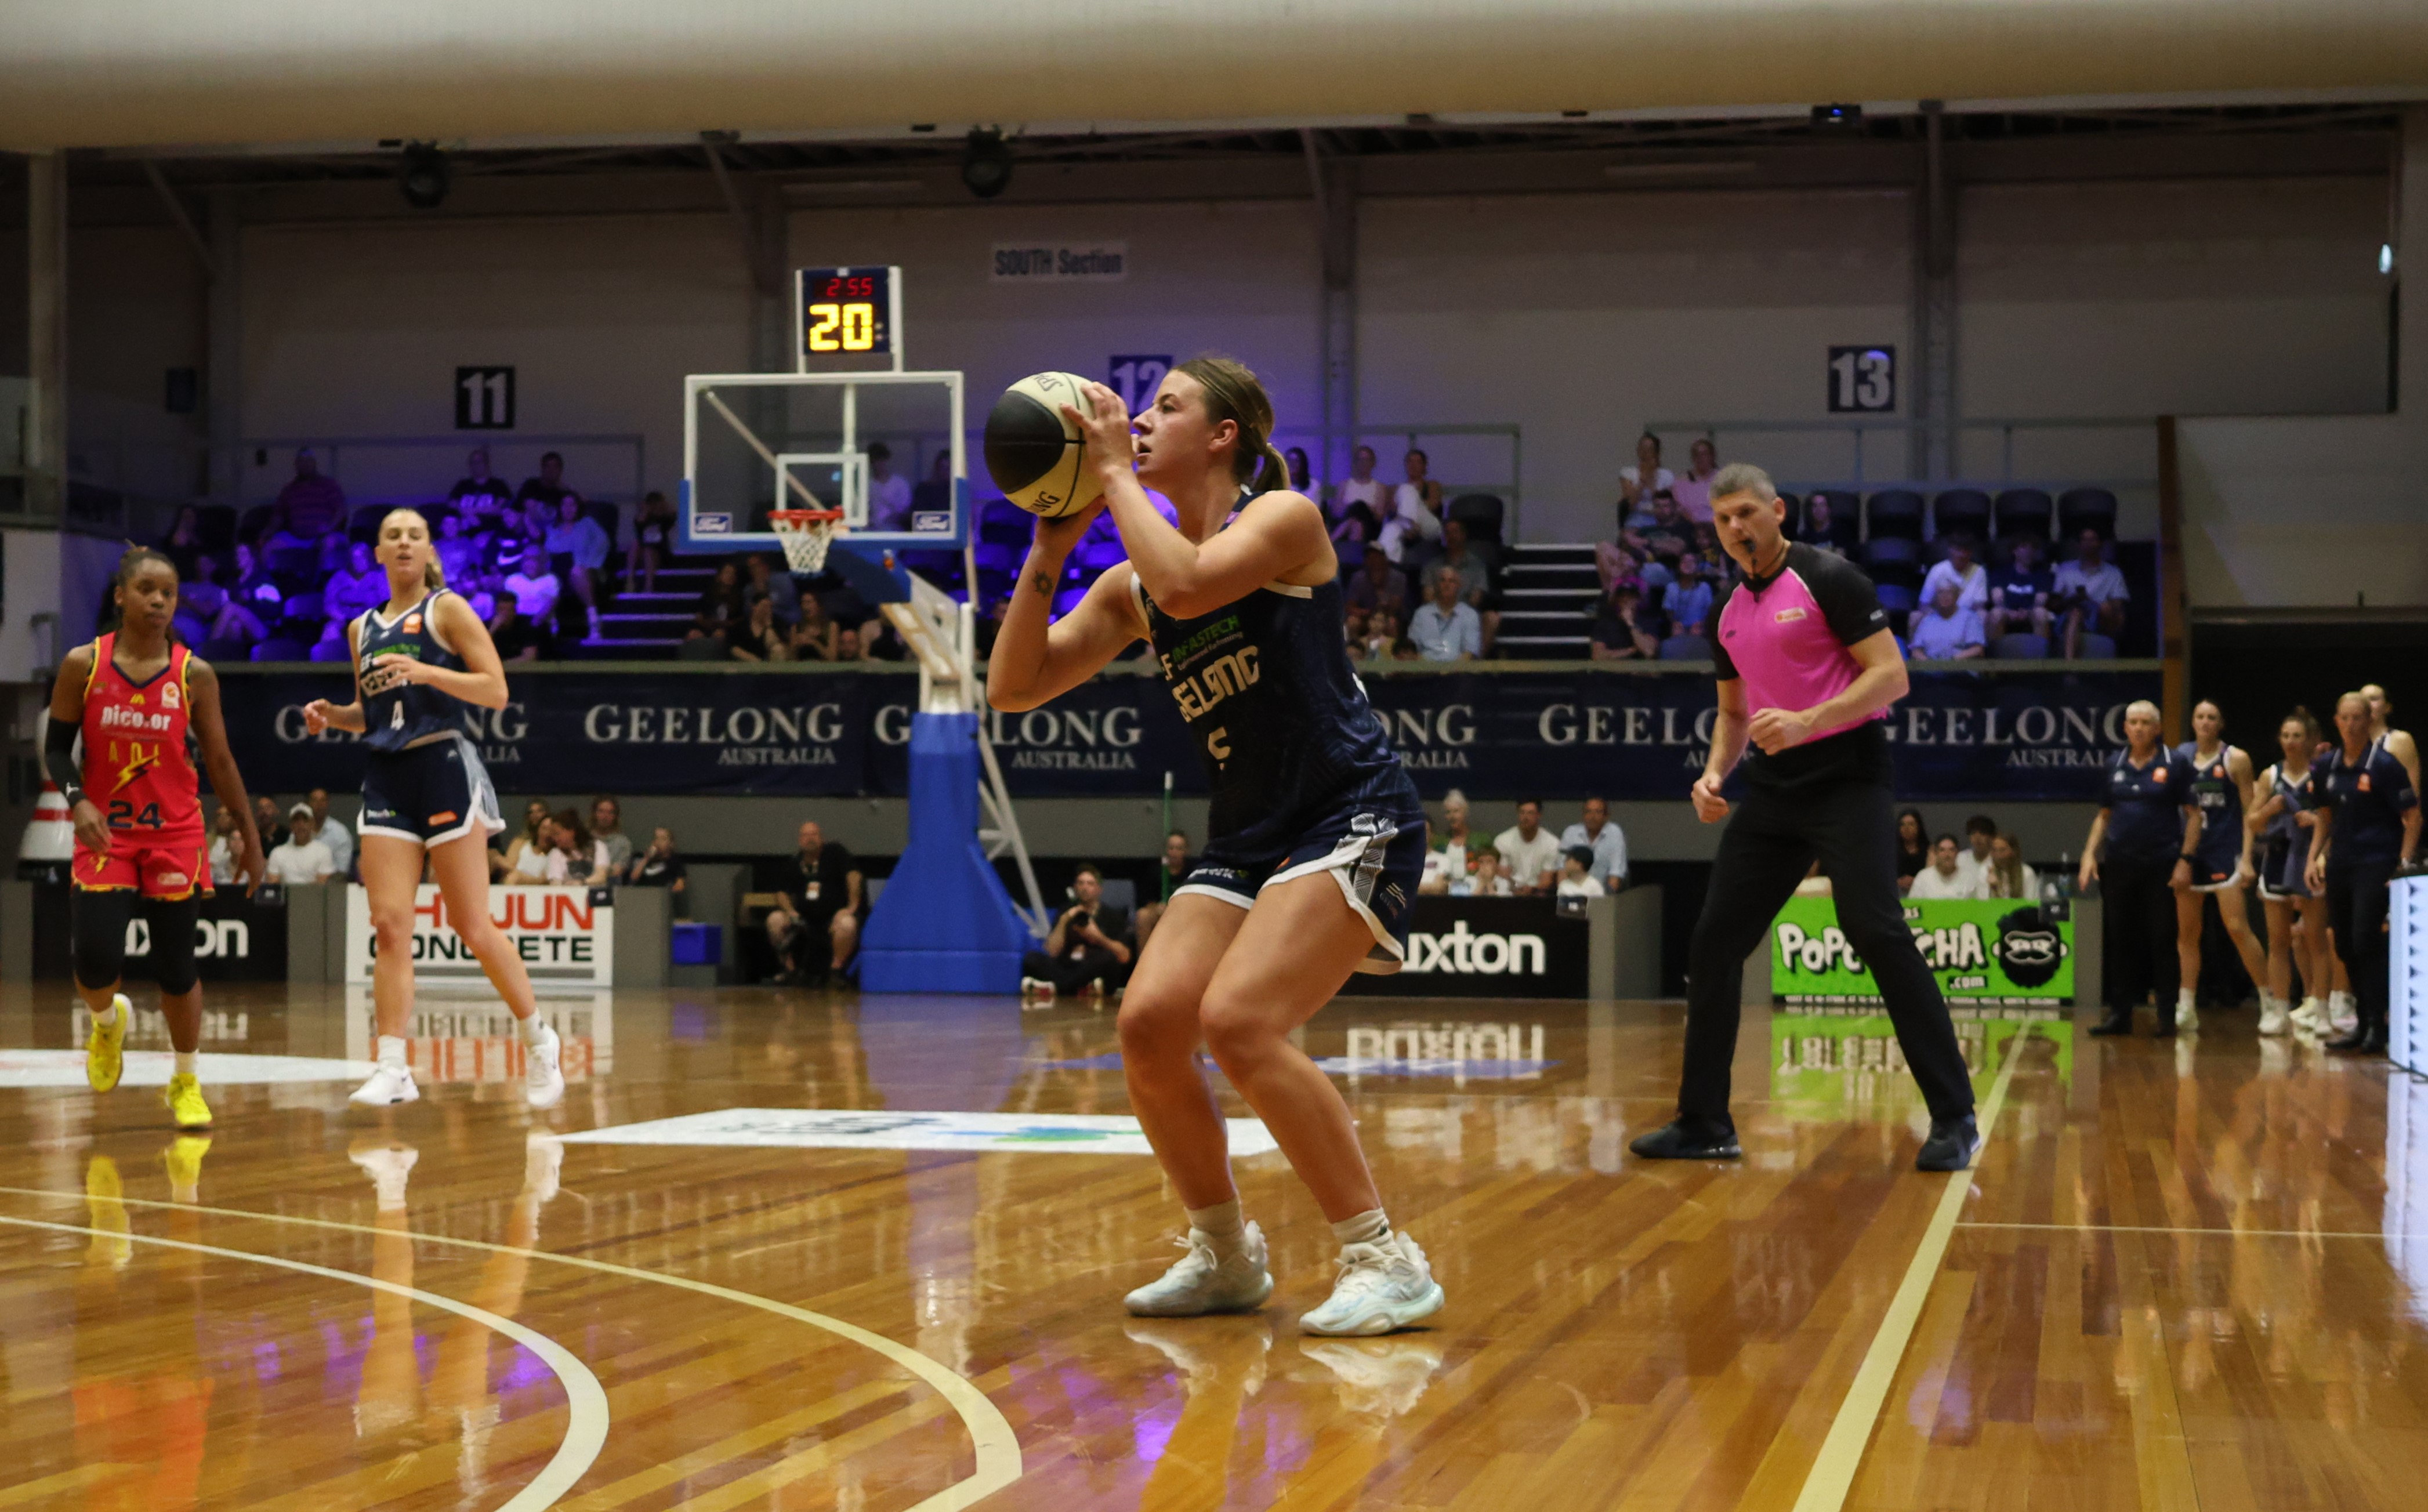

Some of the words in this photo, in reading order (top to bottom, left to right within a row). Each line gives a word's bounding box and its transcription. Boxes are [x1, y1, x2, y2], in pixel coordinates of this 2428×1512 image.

[995, 250, 1052, 275] SOUTH
[1059, 249, 1122, 274] Section
[810, 303, 872, 350] 20
[462, 372, 506, 424] 11
[1113, 360, 1167, 415] 12
[1831, 350, 1891, 408] 13
[391, 701, 405, 731] 4
[584, 704, 843, 744] GEELONG
[875, 705, 1143, 747] GLONG
[1538, 704, 1717, 746] GEEL
[1884, 704, 2128, 745] EELON
[718, 748, 836, 766] AUSTRALIA
[1012, 750, 1135, 769] AUSTRALIA
[1400, 750, 1470, 768] RALIA
[2006, 749, 2104, 767] AUSTRA
[107, 800, 166, 829] 24
[369, 934, 593, 962] ONETE
[1401, 920, 1546, 975] uxton
